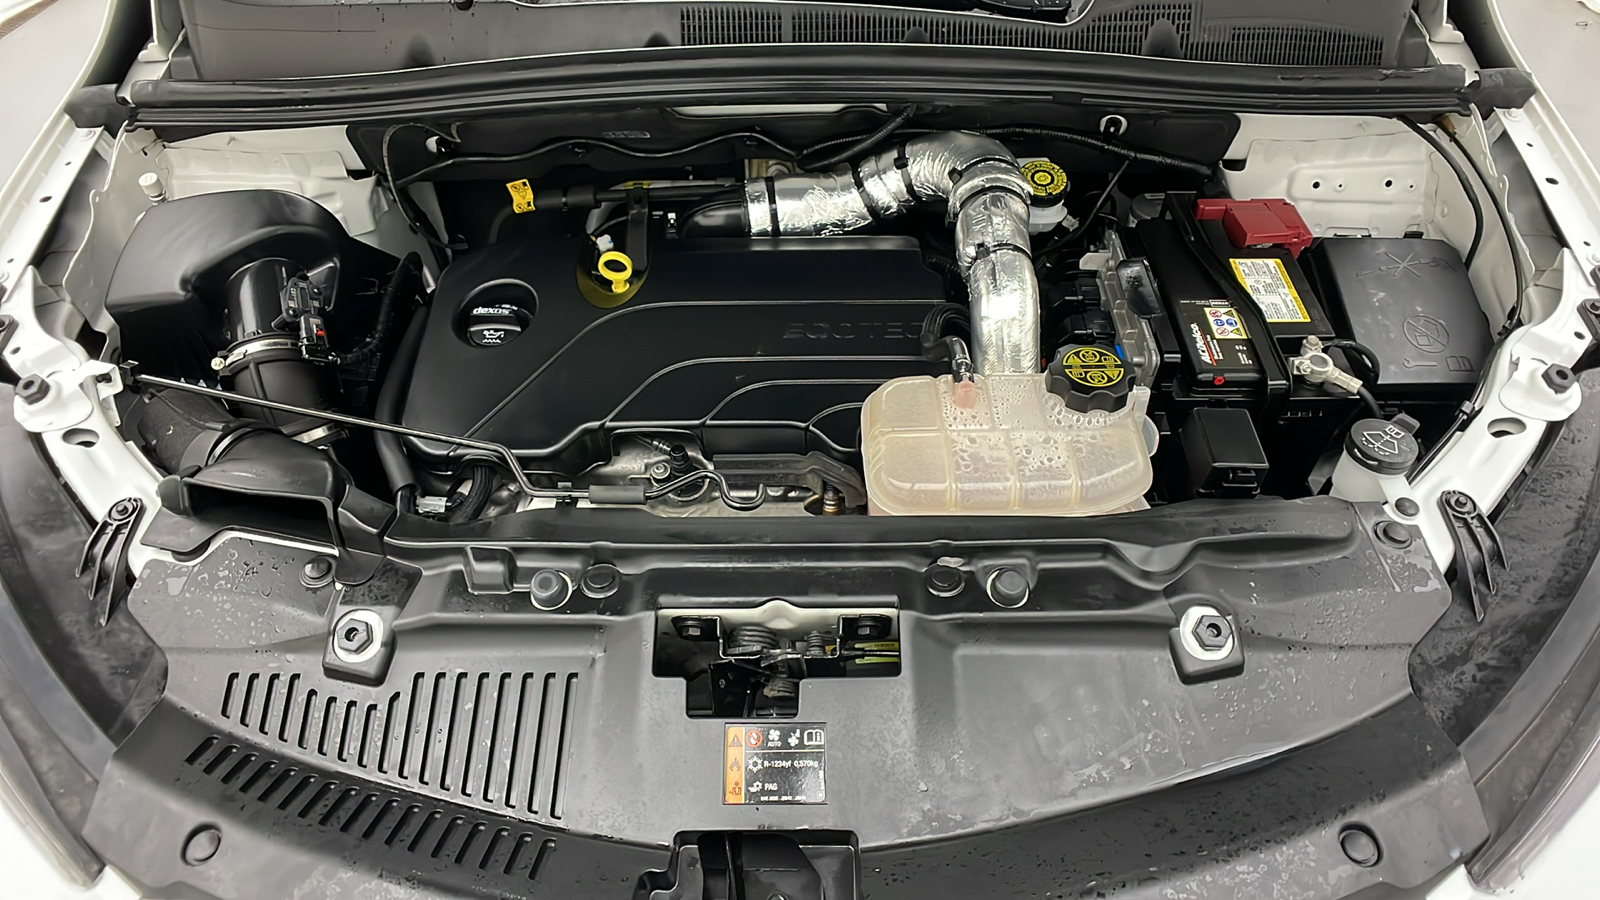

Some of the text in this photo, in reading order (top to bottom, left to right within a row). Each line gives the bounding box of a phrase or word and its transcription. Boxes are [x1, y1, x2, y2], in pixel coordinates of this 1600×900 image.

[473, 306, 512, 314] dexos
[763, 760, 791, 769] R-1234yf
[764, 783, 778, 791] PAG
